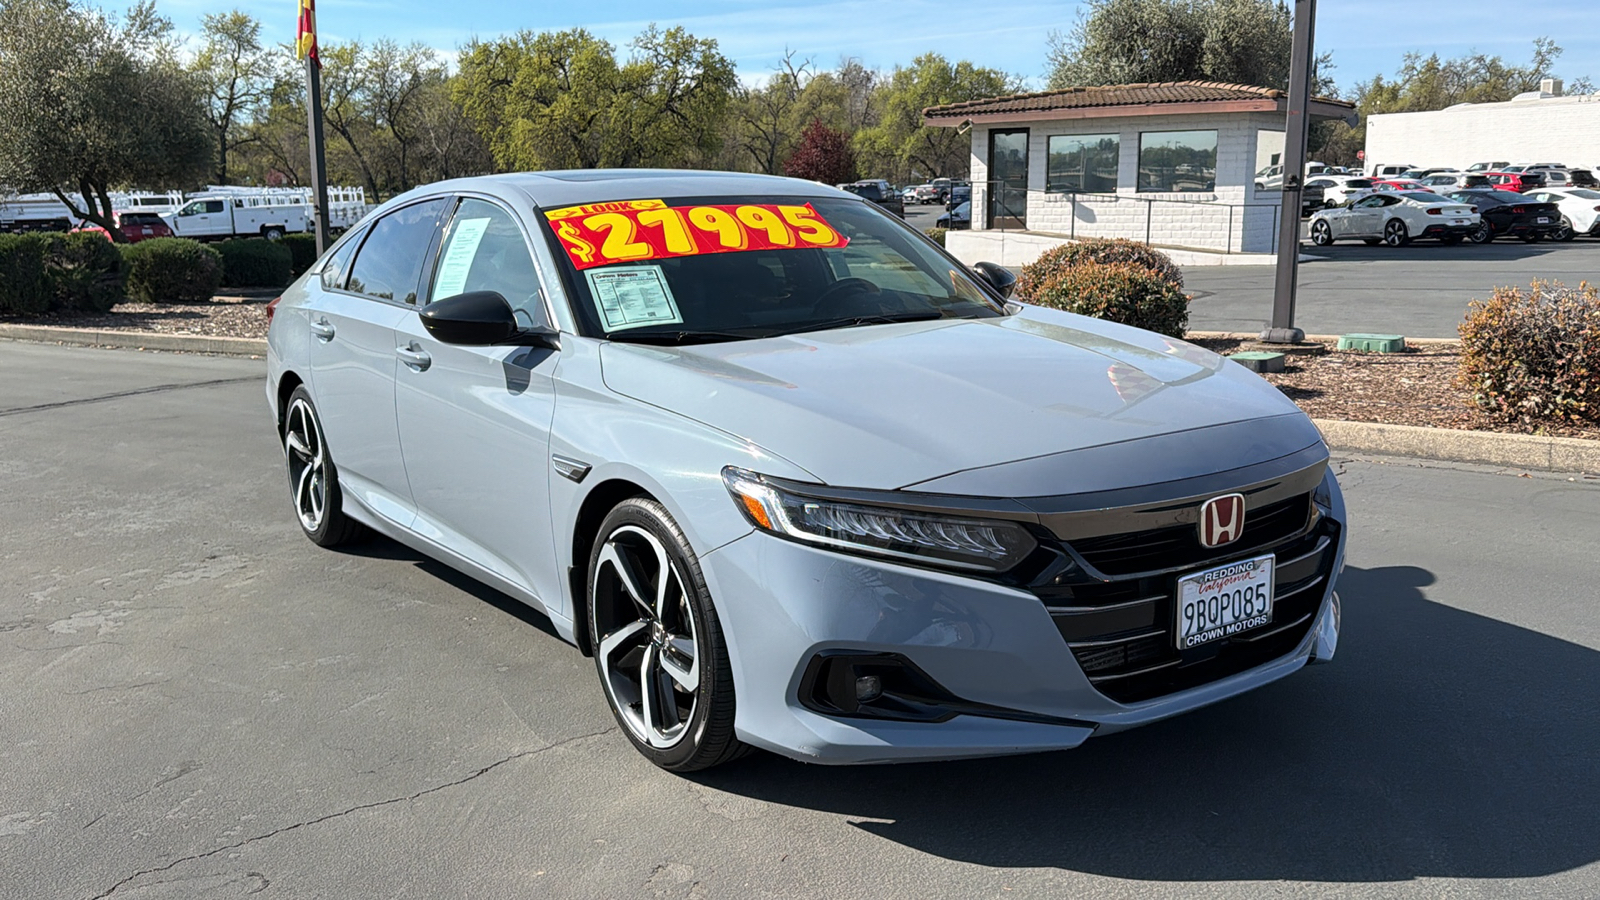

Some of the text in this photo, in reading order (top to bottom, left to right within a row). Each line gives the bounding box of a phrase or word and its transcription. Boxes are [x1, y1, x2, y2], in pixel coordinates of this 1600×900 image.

[579, 202, 634, 214] LOOK
[558, 205, 839, 263] $27995
[1198, 571, 1257, 595] California
[1204, 562, 1254, 582] REDDING
[1184, 583, 1266, 636] 9BQP085
[1186, 615, 1268, 647] CROWN MOTORS
